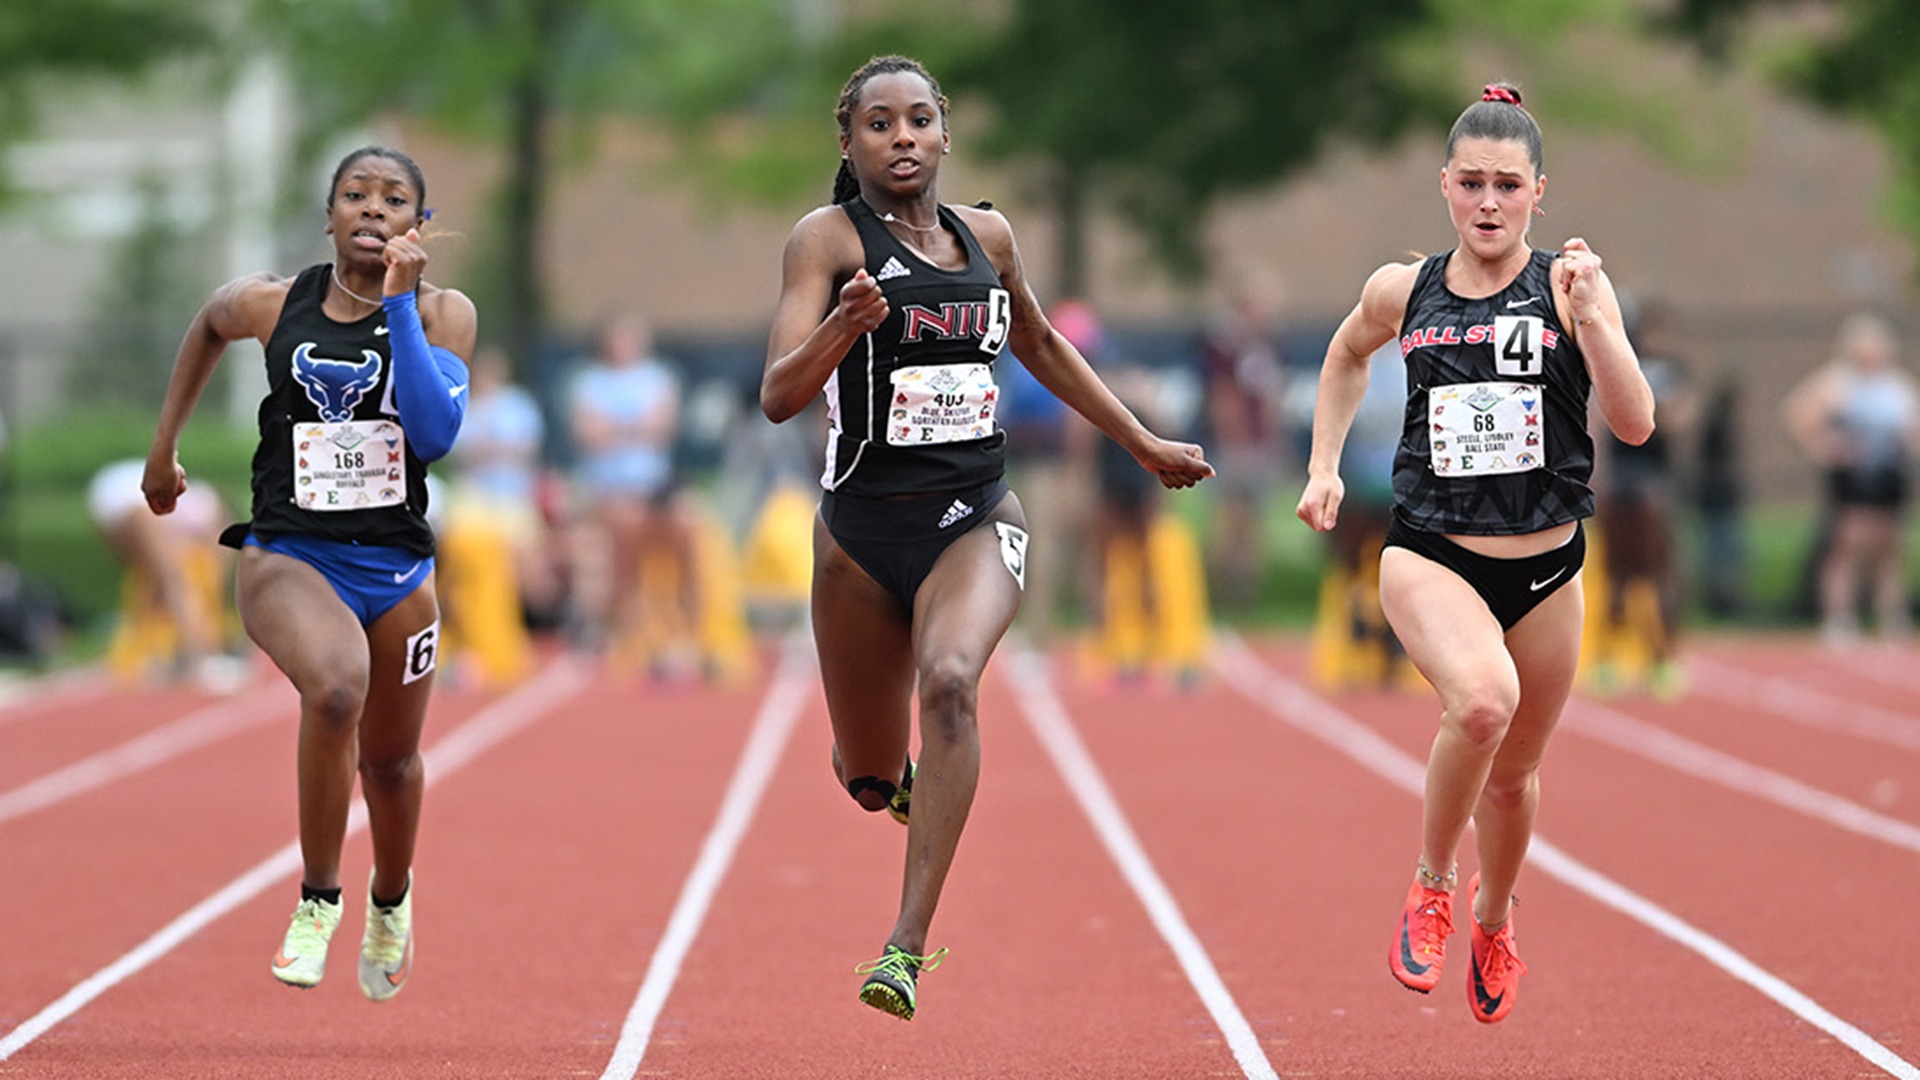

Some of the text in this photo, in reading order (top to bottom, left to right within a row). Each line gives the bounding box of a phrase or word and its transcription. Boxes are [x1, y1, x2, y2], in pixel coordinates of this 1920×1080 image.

[987, 294, 1007, 351] 5
[1464, 325, 1559, 350] STE
[1502, 319, 1533, 372] 4
[1473, 413, 1495, 433] 68
[334, 451, 365, 469] 168
[938, 506, 974, 529] adidas
[411, 630, 434, 676] 6
